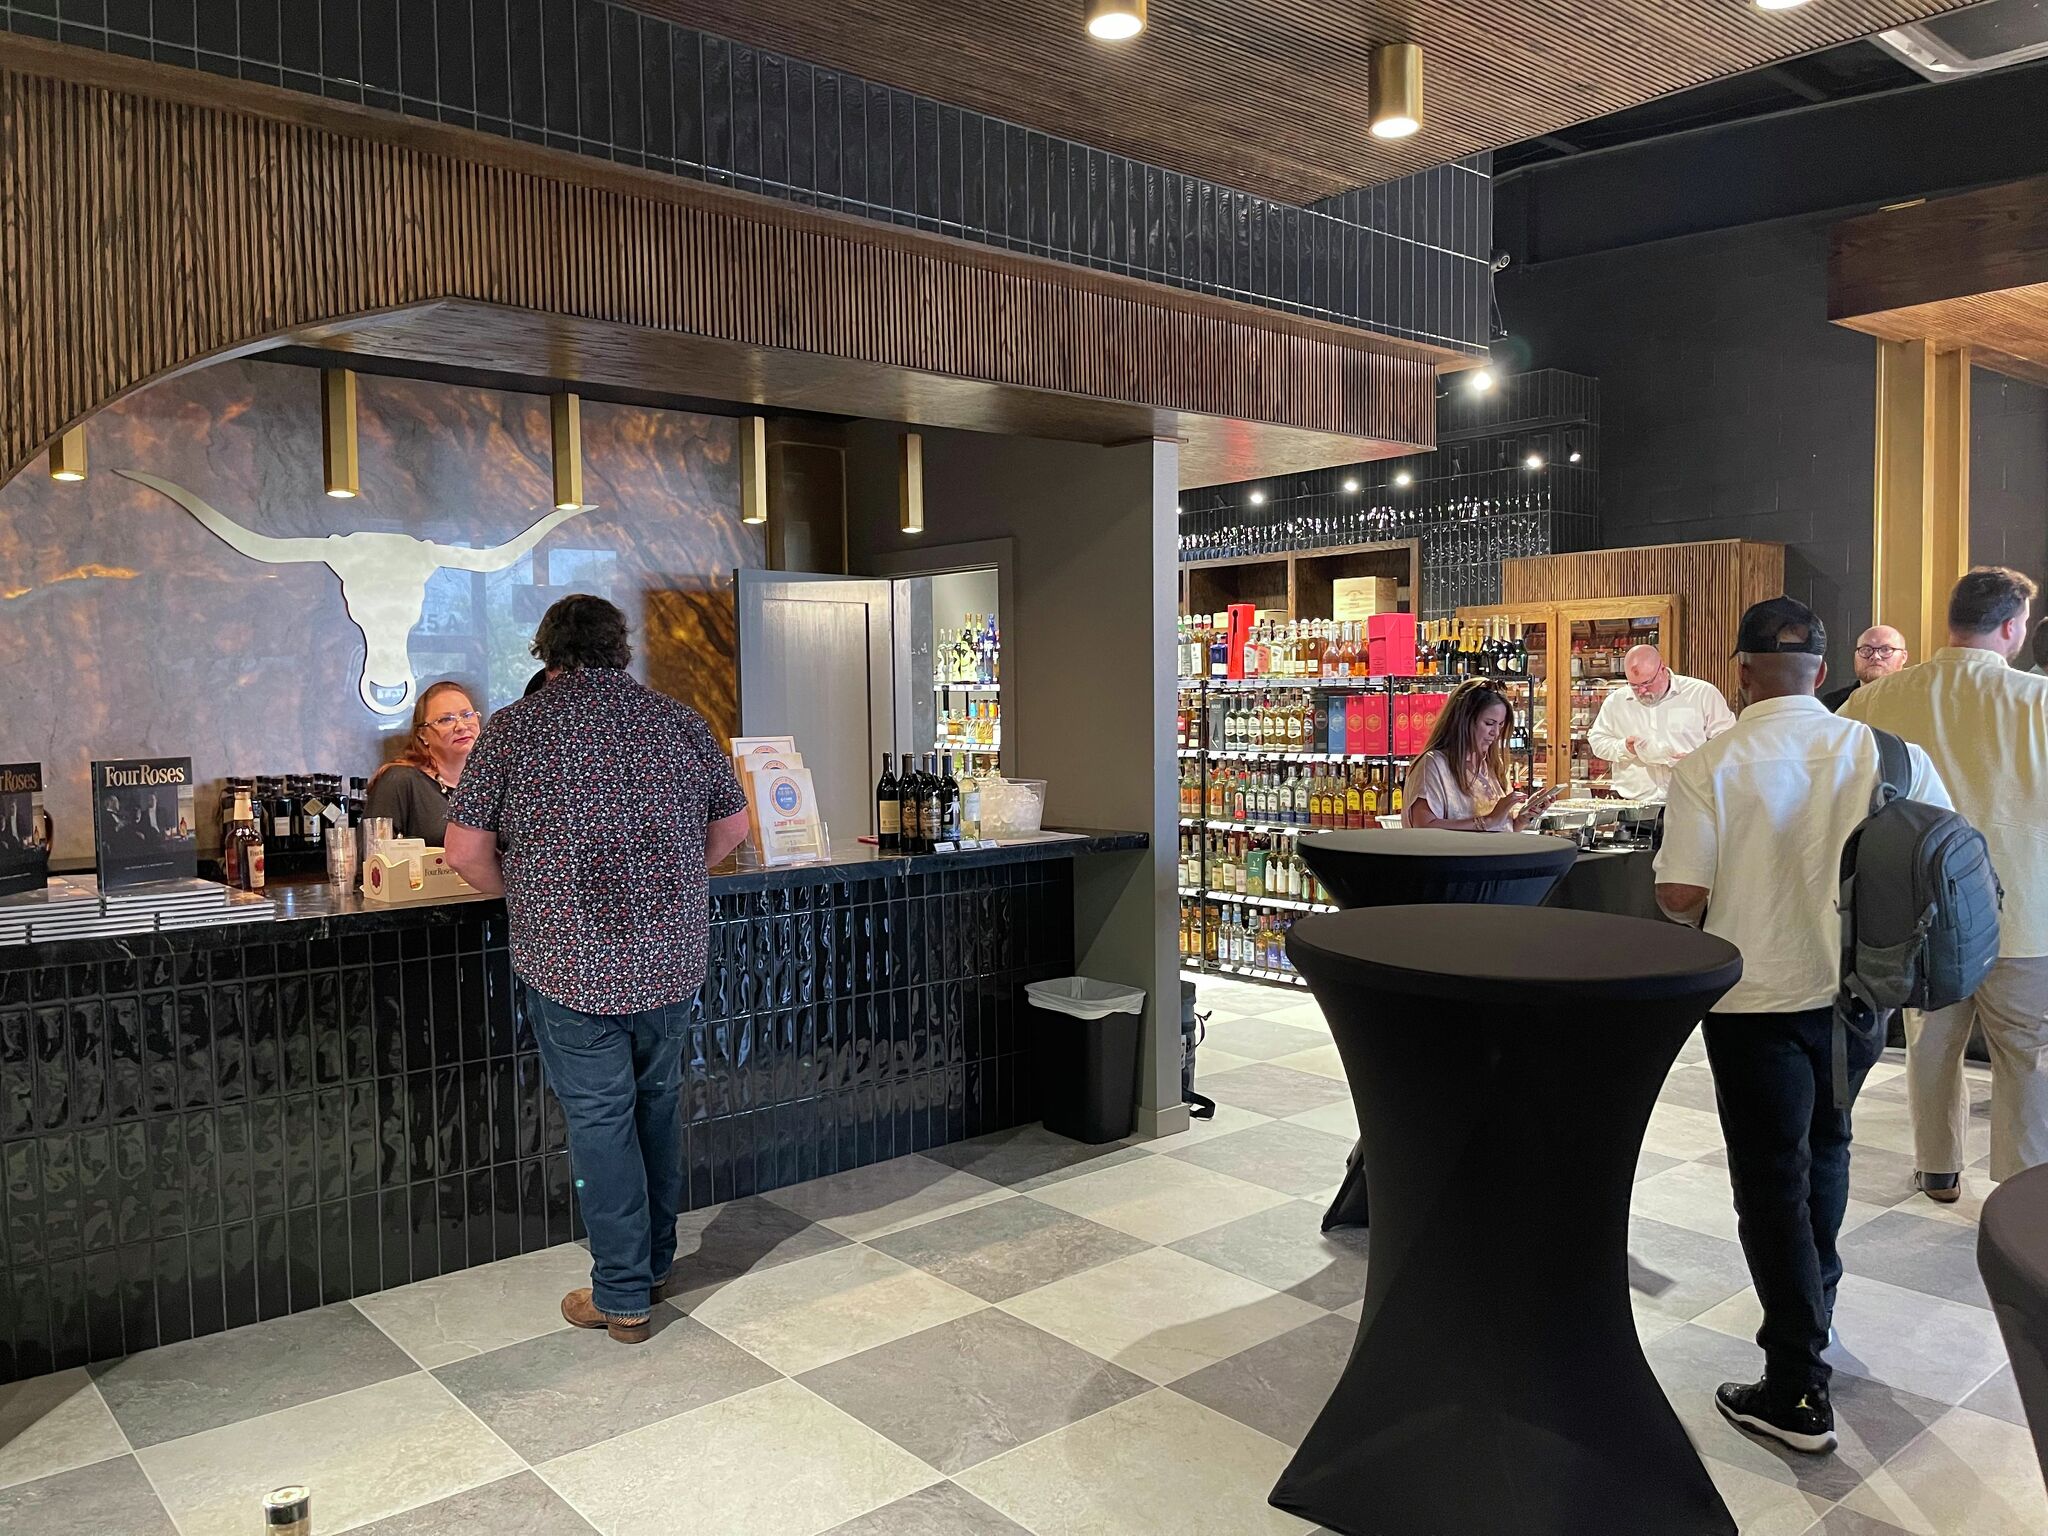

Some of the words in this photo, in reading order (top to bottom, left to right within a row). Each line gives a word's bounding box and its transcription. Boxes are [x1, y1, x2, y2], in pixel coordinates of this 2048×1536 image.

[4, 769, 37, 792] Roses
[104, 765, 139, 787] Four
[139, 764, 185, 786] Roses
